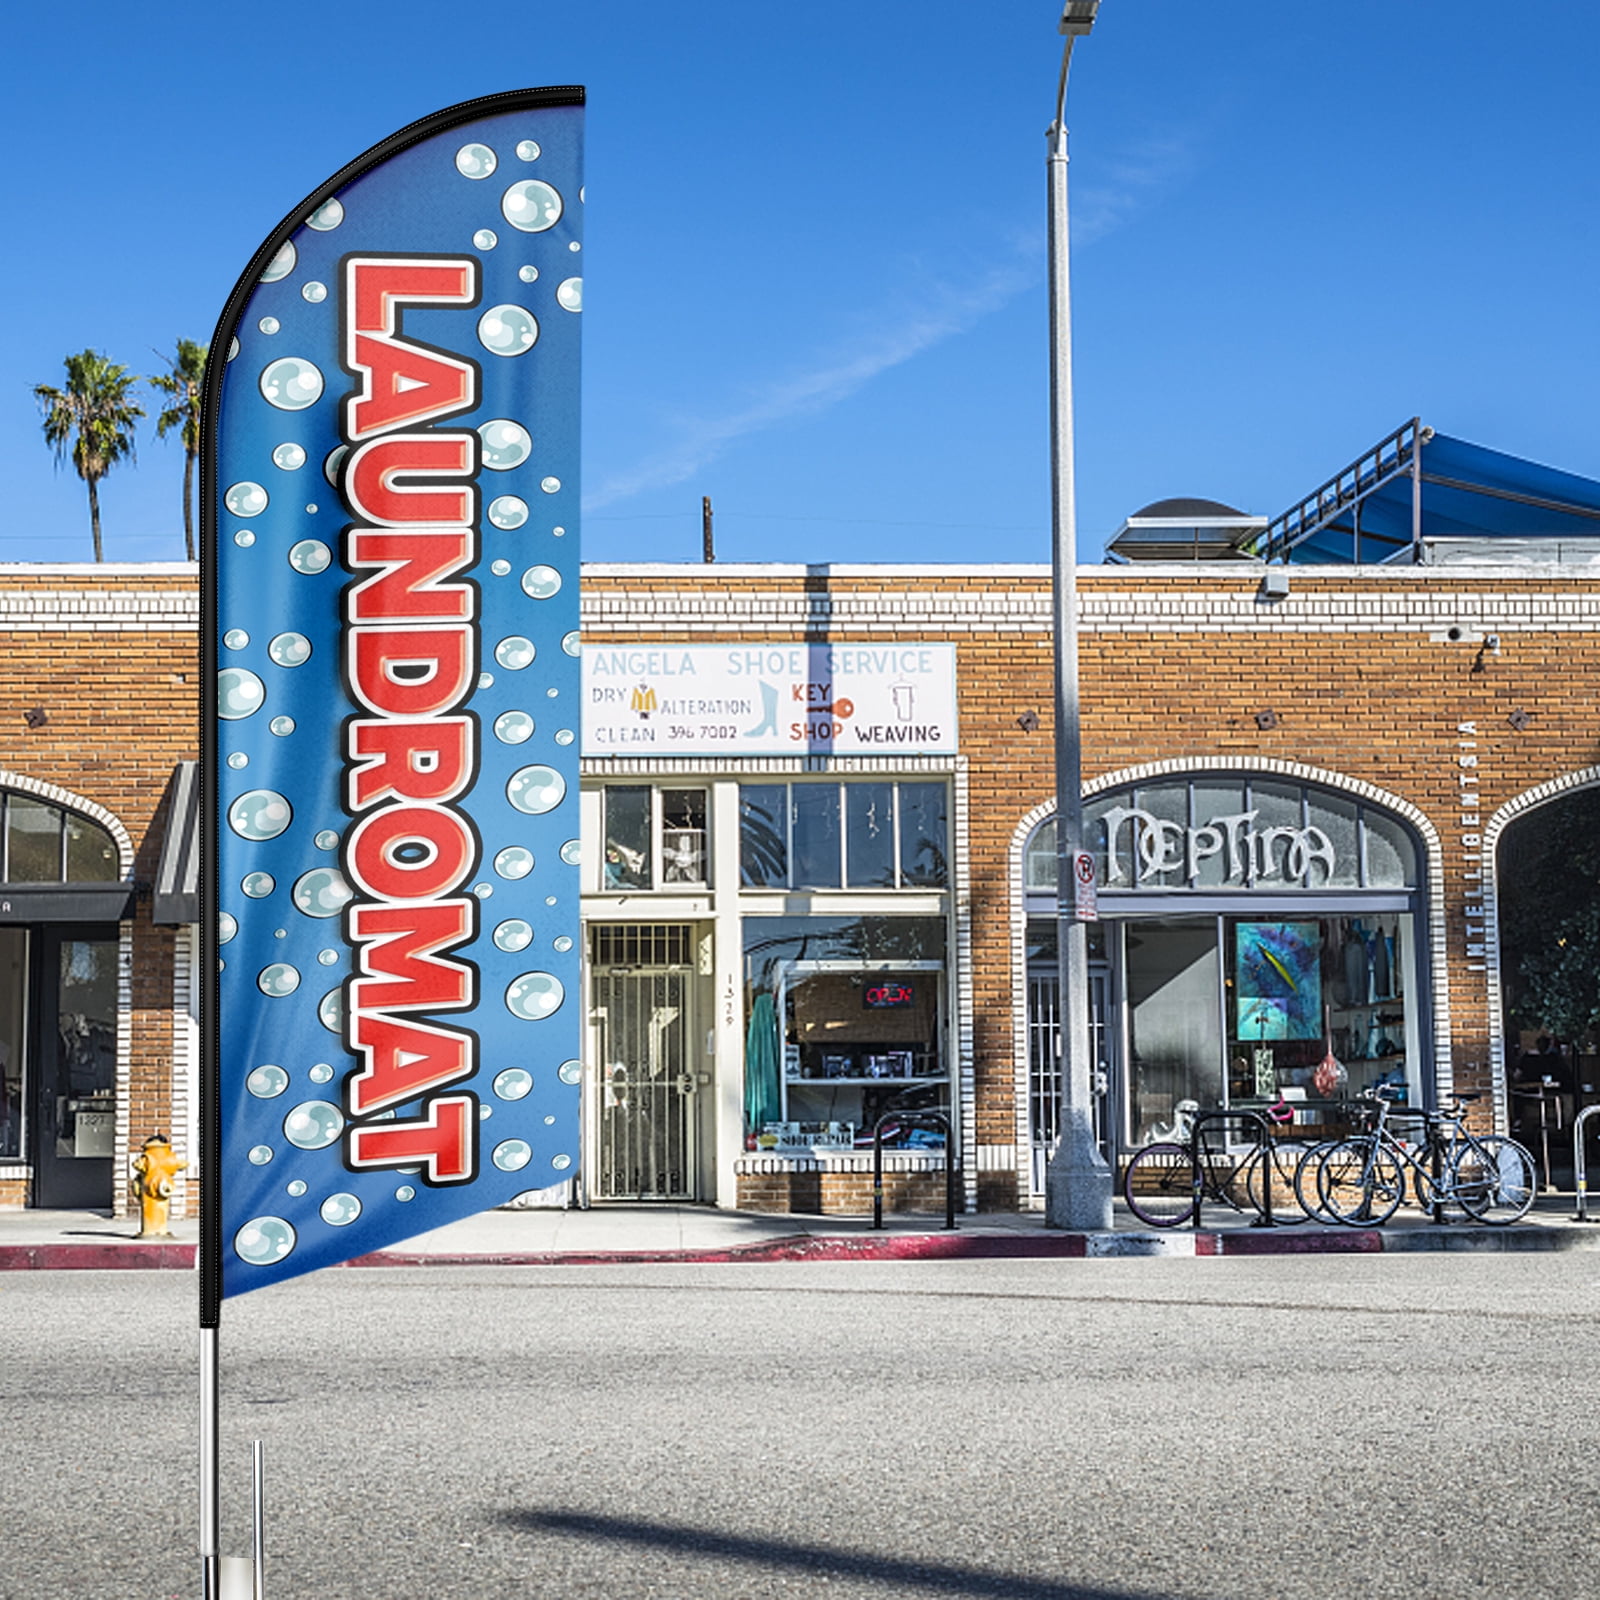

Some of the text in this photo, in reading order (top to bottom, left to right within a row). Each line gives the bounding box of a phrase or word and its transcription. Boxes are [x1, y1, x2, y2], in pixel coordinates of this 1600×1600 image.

[592, 650, 933, 676] ANGELA SHOE SERVICE
[592, 687, 627, 703] DRY
[791, 683, 832, 702] KEY
[660, 699, 751, 716] ALTERATION
[340, 254, 481, 1187] LAUNDROMAT
[595, 726, 655, 744] CLEAN
[789, 722, 843, 741] SHOP
[855, 725, 942, 743] WEAVING
